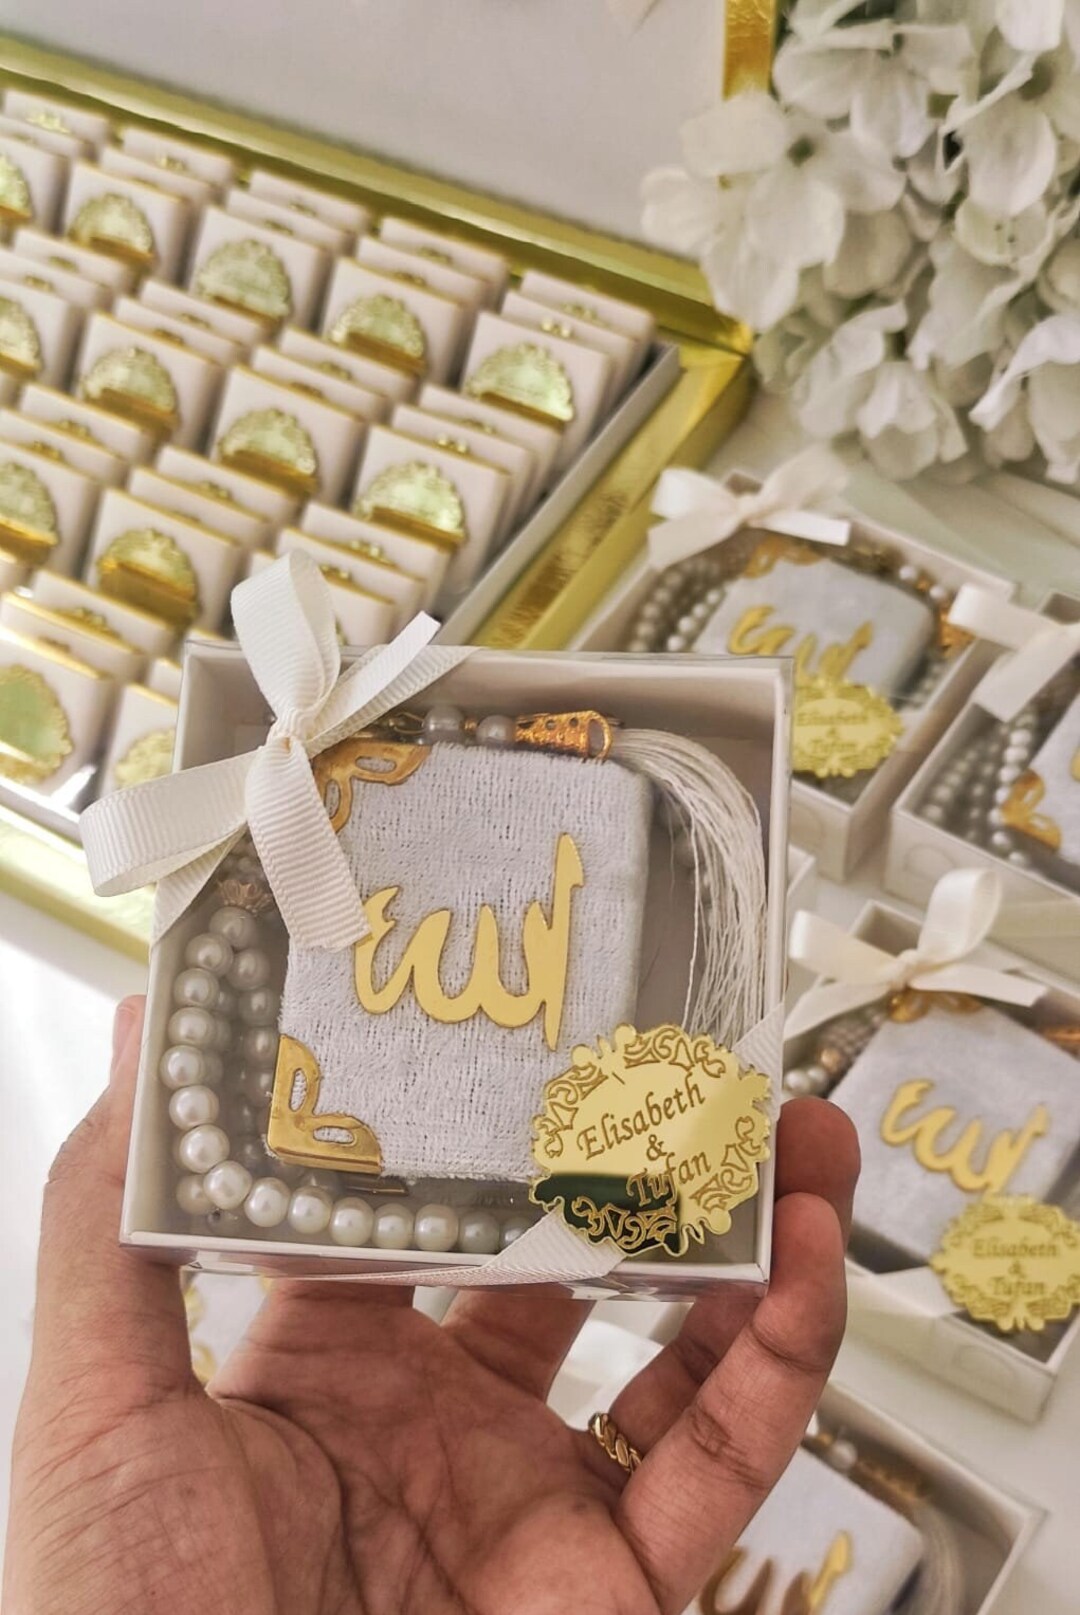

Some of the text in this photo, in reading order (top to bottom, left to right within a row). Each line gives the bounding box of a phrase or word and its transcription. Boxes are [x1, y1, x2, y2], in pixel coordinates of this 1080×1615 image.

[576, 1072, 706, 1161] Elisabeth
[646, 1134, 667, 1161] &
[626, 1152, 712, 1205] Tufan
